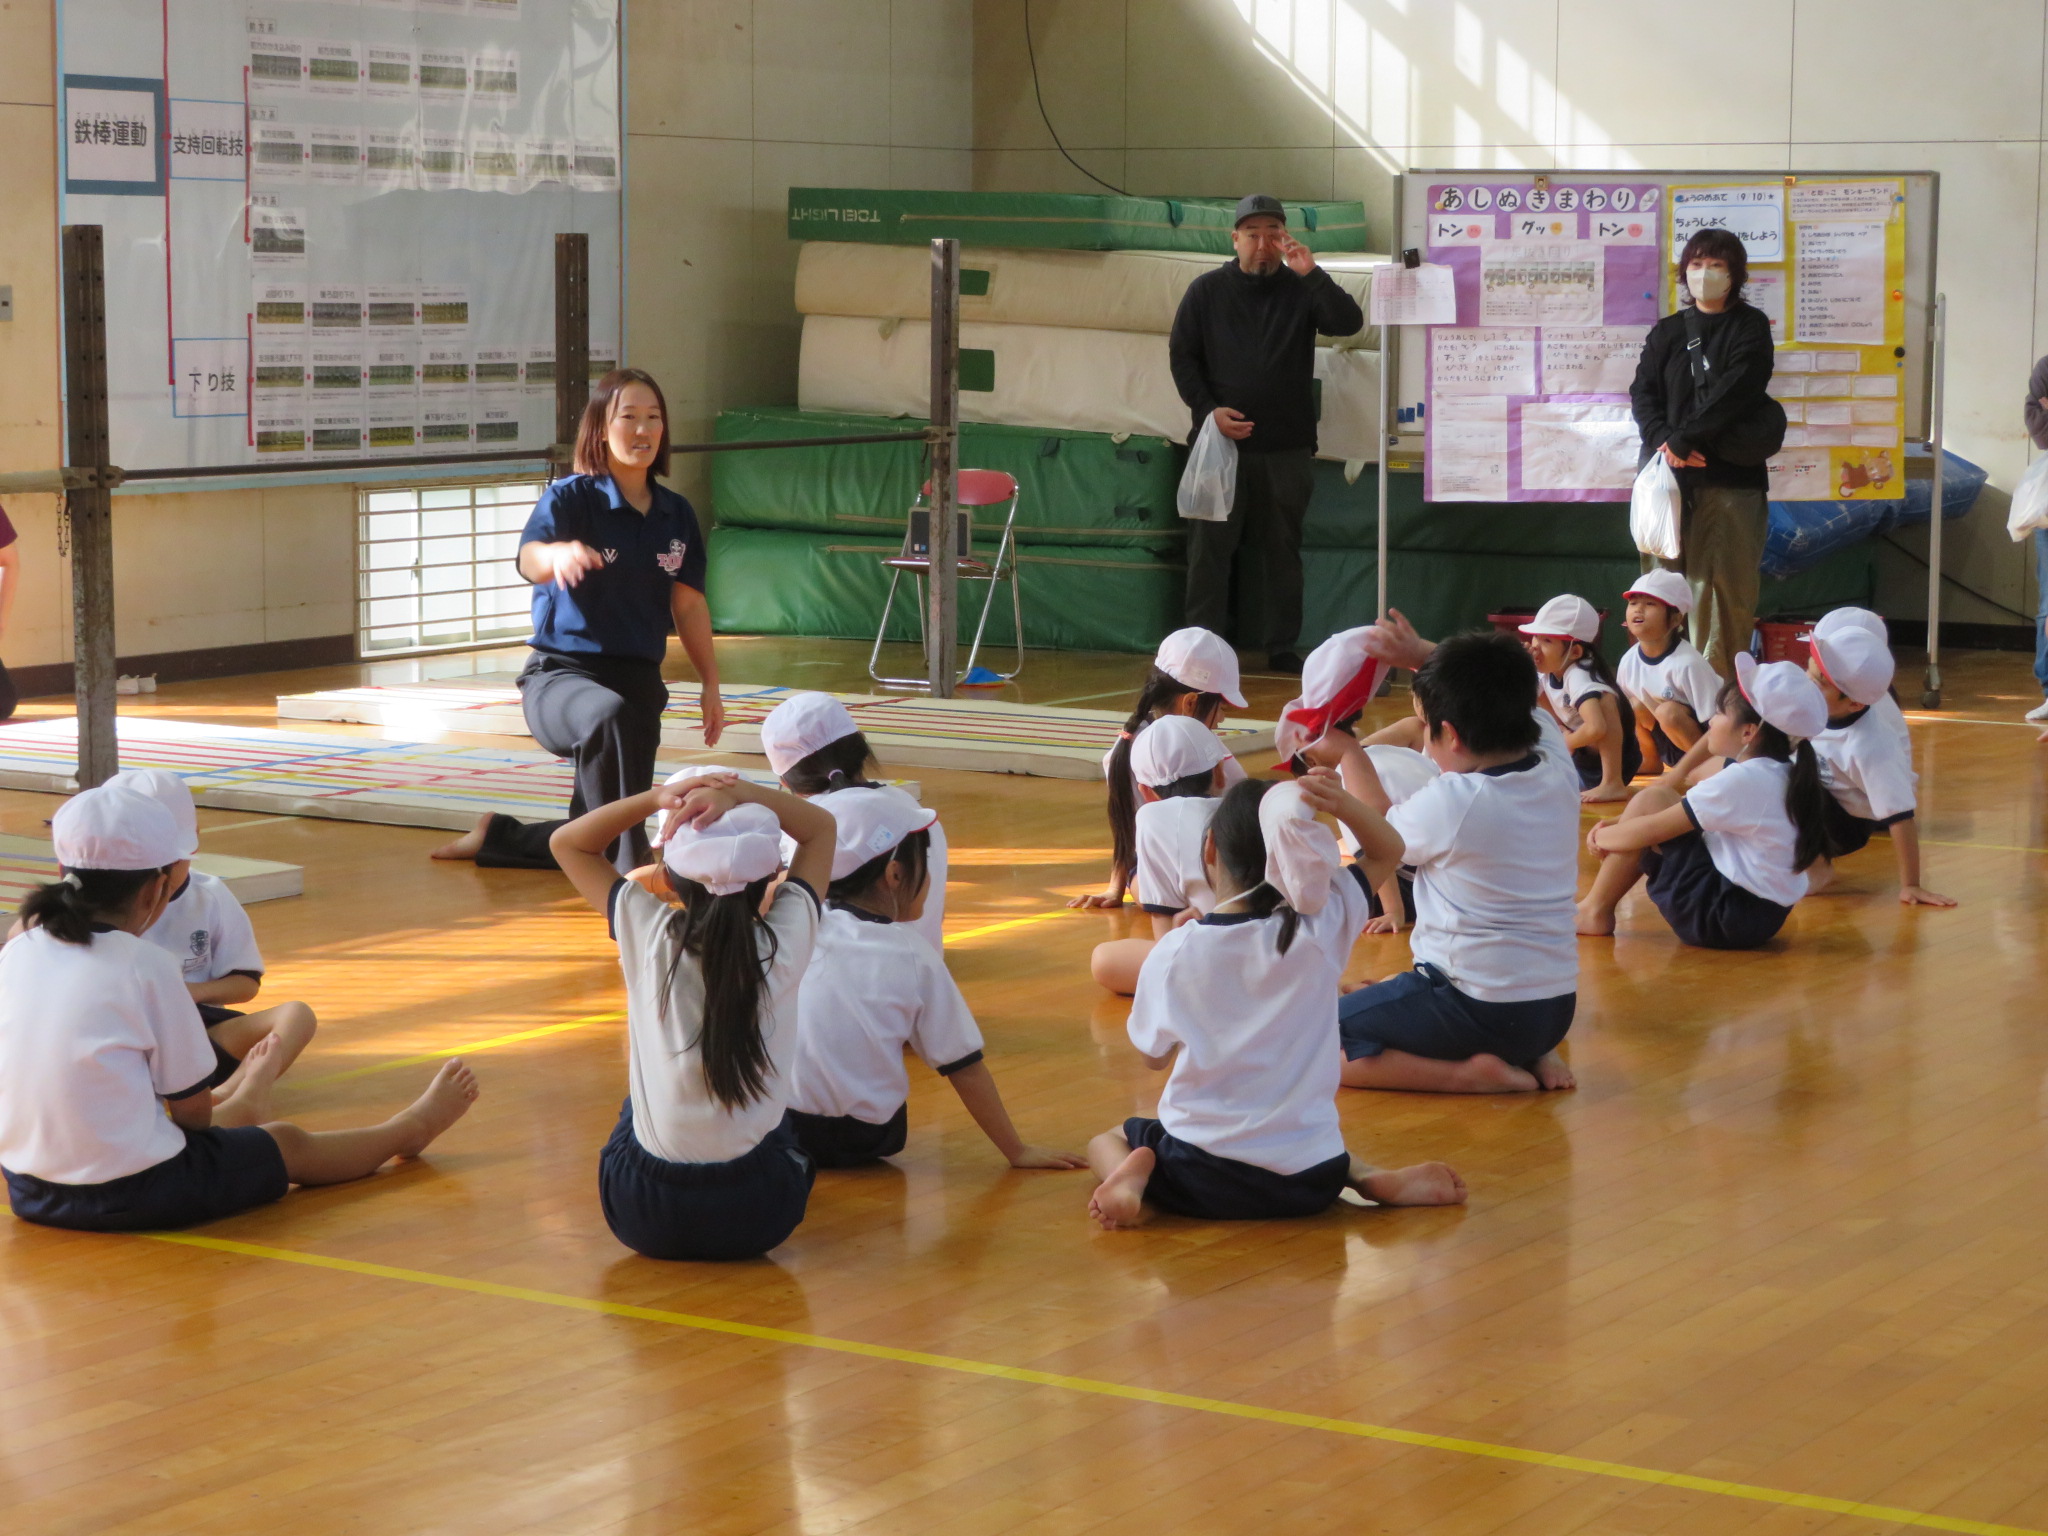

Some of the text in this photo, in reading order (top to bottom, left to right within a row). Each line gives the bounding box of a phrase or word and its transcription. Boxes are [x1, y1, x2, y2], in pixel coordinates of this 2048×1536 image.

[74, 118, 147, 147] 鉄棒運動
[172, 134, 244, 156] 支持回転技
[1442, 187, 1631, 210] あしぬきまわり
[1676, 193, 1728, 203] ょうのめあて
[791, 207, 881, 222] TOEI LIGHT
[1675, 217, 1727, 227] ちょうしよく
[1438, 223, 1463, 238] トン
[1521, 220, 1545, 235] グッ
[1599, 222, 1625, 237] トン
[1675, 231, 1778, 243] あしりをしよう
[188, 372, 236, 393] 下り技
